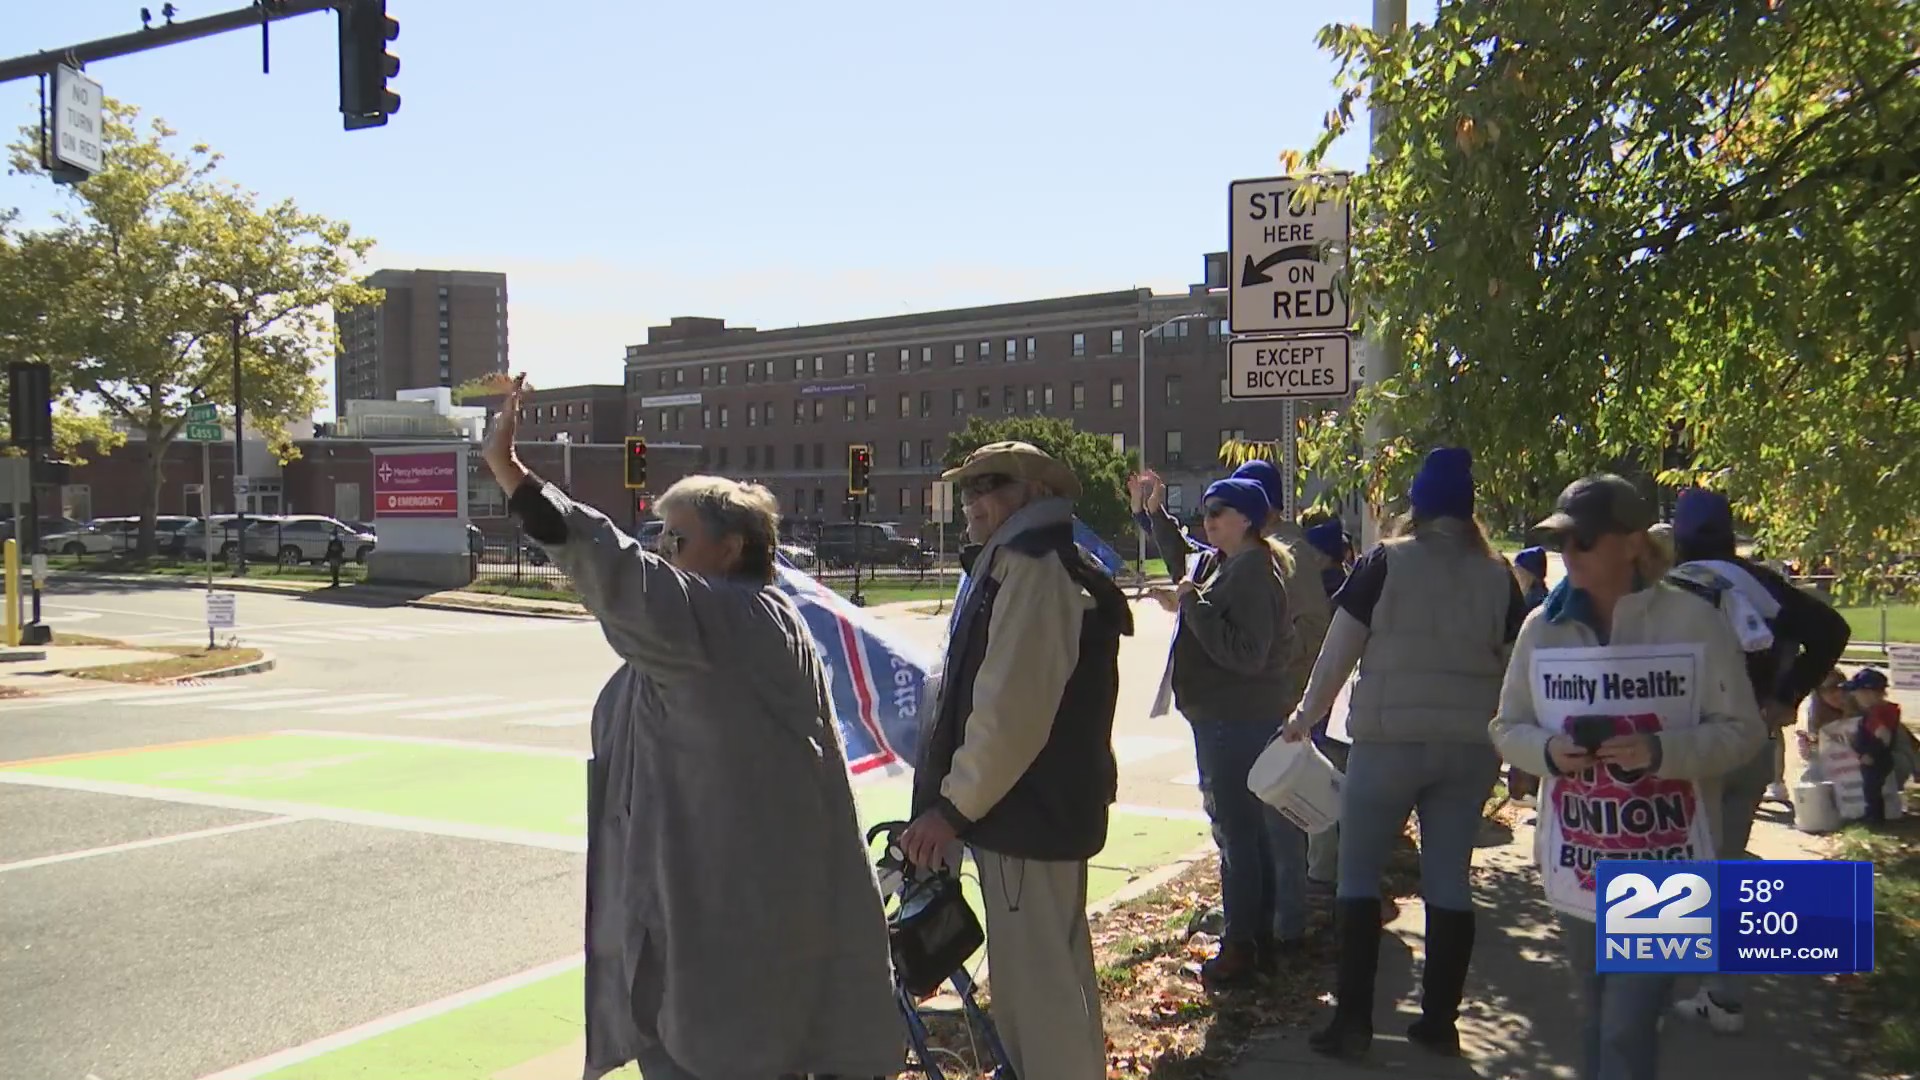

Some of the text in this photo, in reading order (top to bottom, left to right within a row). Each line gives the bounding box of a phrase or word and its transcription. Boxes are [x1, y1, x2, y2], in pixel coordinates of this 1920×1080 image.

[72, 83, 88, 106] NO
[67, 107, 93, 134] TURN
[62, 131, 97, 162] ON RED
[1264, 223, 1314, 243] HERE
[1288, 265, 1315, 284] ON
[1273, 289, 1335, 320] RED
[1256, 346, 1325, 366] EXCEPT
[1247, 367, 1334, 389] BICYCLES
[191, 426, 212, 439] Cass
[394, 466, 455, 477] Mercy Medical Center
[397, 496, 444, 506] EMERGENCY
[1543, 670, 1686, 705] Trinity Health:
[1562, 792, 1688, 837] UNION
[1559, 844, 1694, 871] BUG!
